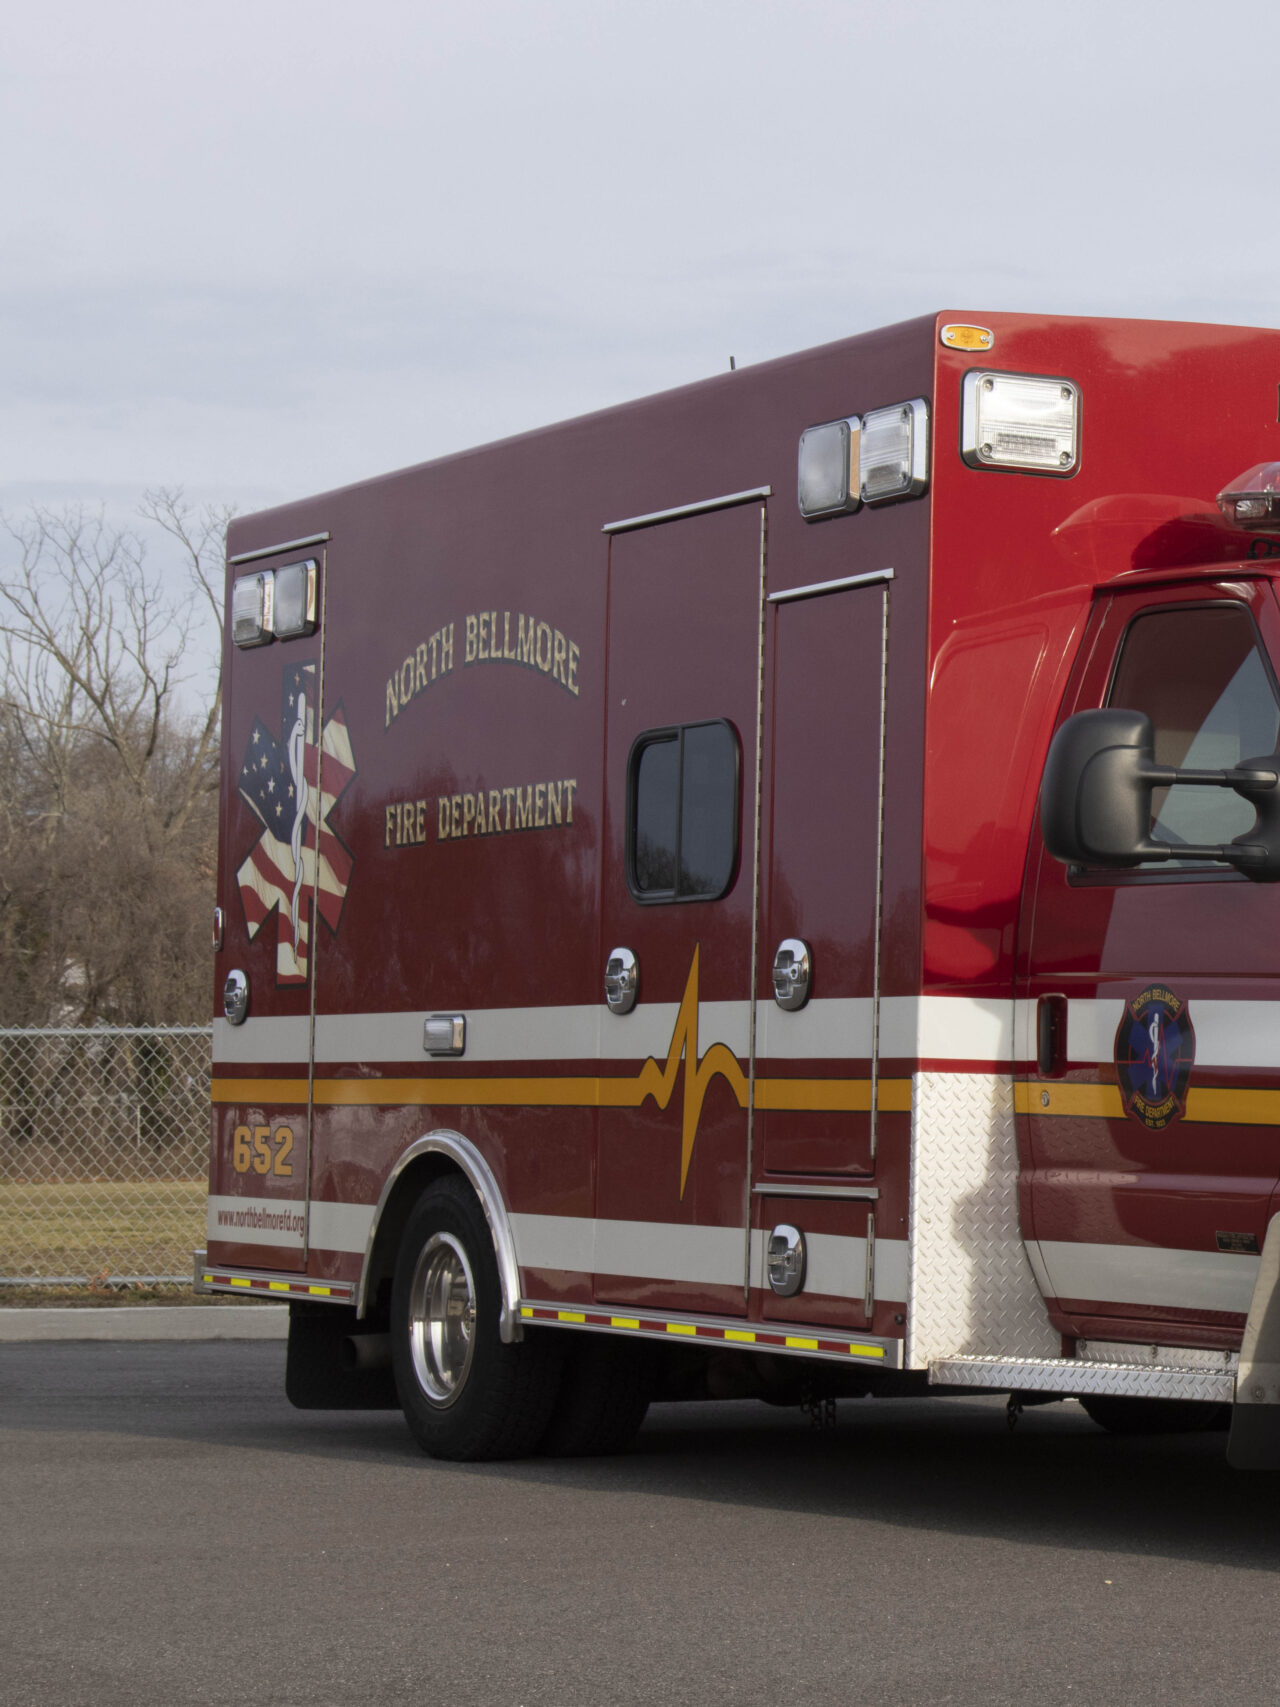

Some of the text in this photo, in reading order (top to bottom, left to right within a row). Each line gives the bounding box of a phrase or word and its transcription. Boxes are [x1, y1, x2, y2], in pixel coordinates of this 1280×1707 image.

[385, 611, 581, 730] NORTH BELLMORE
[384, 778, 577, 848] FIRE DEPARTMENT
[1132, 991, 1151, 1011] NORTH
[232, 1125, 294, 1176] 652
[217, 1206, 305, 1237] www.northbellmorefd.org
